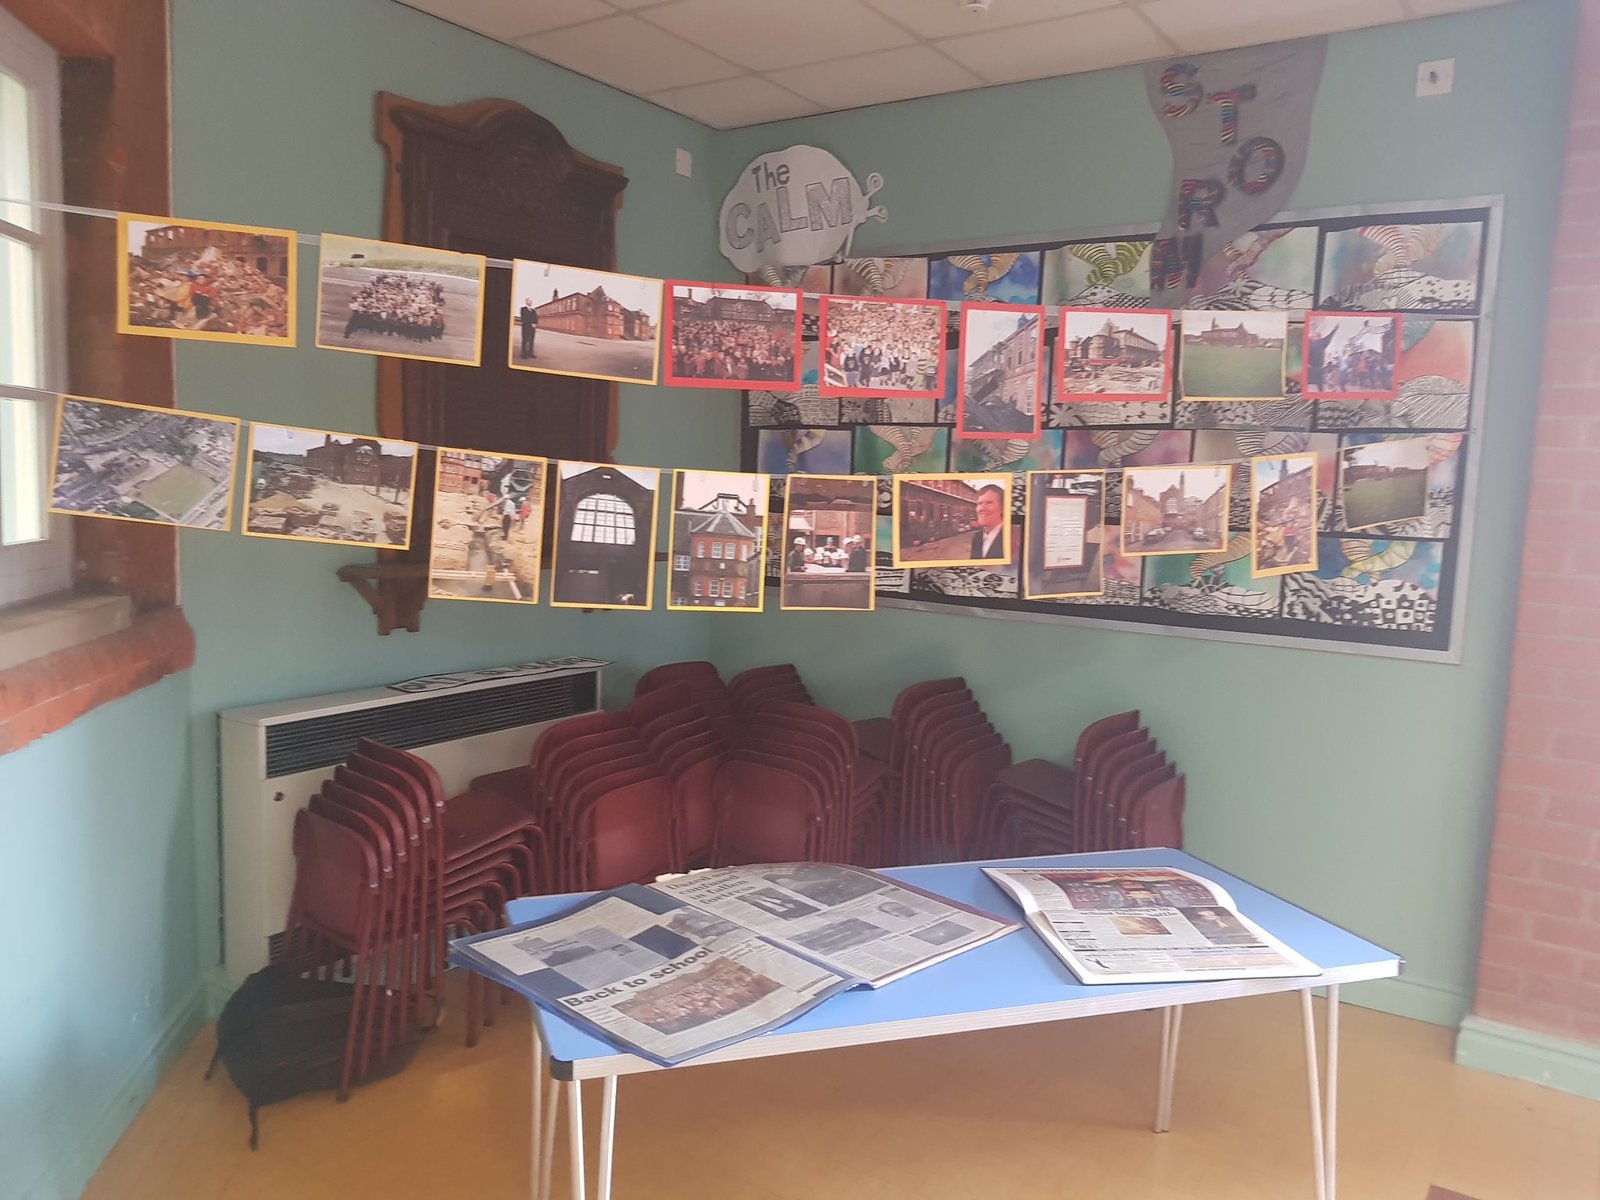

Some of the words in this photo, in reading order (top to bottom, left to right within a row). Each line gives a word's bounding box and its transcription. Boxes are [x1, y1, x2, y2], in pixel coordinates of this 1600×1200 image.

[751, 161, 791, 194] The
[726, 176, 853, 254] CALM
[678, 874, 741, 895] confused
[699, 886, 757, 904] fortress
[705, 880, 749, 894] fallen
[564, 986, 624, 1008] Back
[623, 977, 647, 989] to
[649, 946, 714, 980] school
